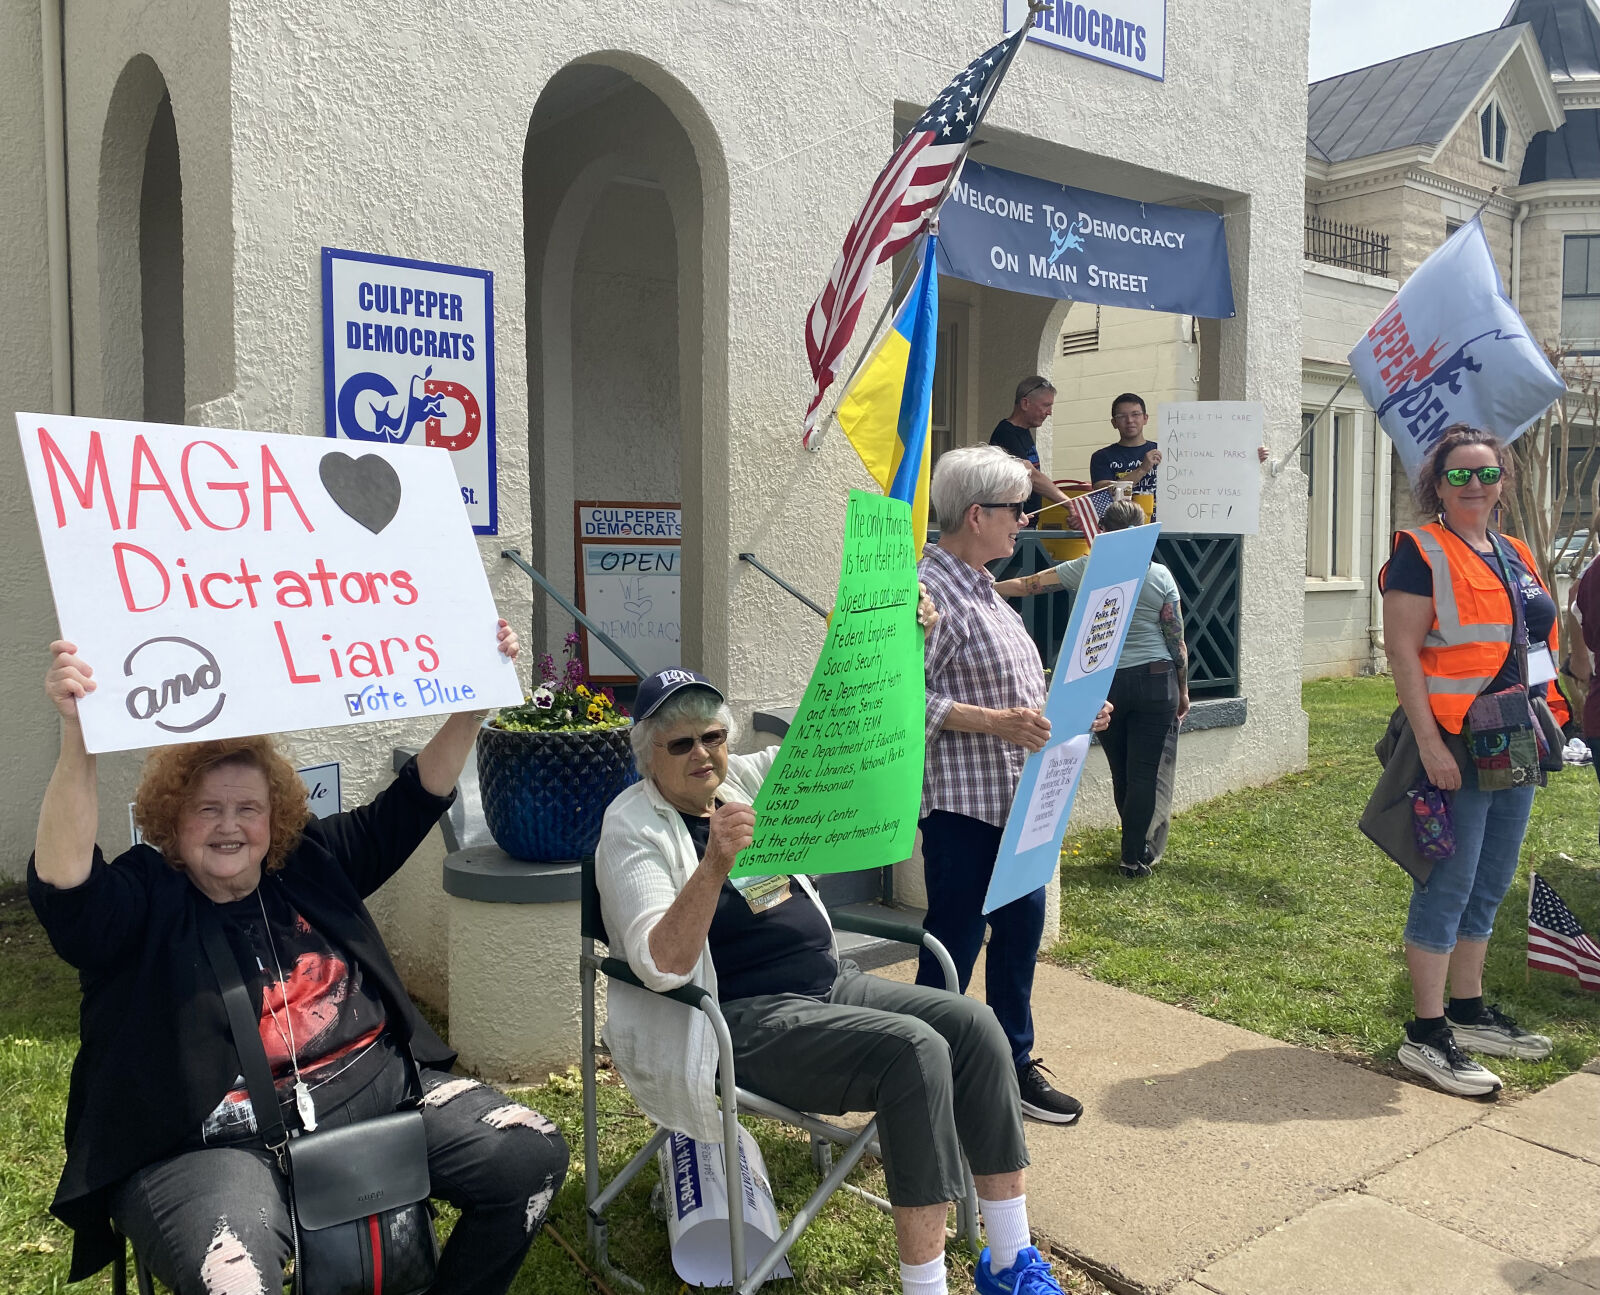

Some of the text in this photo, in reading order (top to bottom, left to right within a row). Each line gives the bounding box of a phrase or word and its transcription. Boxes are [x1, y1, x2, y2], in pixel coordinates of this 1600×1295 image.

[952, 180, 1033, 224] WELCOME
[1078, 212, 1185, 250] DEMOCRACY
[990, 245, 1148, 293] ON MAIN STREET
[358, 281, 463, 322] CULPEPER
[346, 320, 475, 362] DEMOCRATS
[1167, 410, 1252, 426] HEALTH CARE
[1168, 428, 1199, 443] ARTS
[1167, 447, 1247, 463] NATIONAL PARKS
[37, 427, 315, 533] MAGA
[1166, 465, 1194, 481] DATA
[1166, 484, 1211, 500] STUDENT
[1217, 487, 1241, 496] VISAS
[585, 522, 681, 537] DEMOCRATS
[591, 509, 676, 524] CULPEPER
[850, 499, 865, 538] The
[866, 503, 884, 546] only
[600, 551, 674, 572] OPEN
[856, 541, 873, 573] fear
[112, 542, 419, 613] Dictators
[619, 575, 651, 601] WE
[841, 584, 867, 625] Speak
[869, 591, 879, 616] up
[1104, 597, 1119, 608] Sorry
[832, 617, 897, 654] Federal Employees
[1085, 642, 1108, 656] Germans
[274, 620, 440, 684] Liars
[823, 652, 884, 680] Social Security
[126, 663, 222, 721] and
[414, 677, 477, 706] Blue
[814, 683, 833, 702] The
[835, 678, 881, 706] Department
[806, 697, 884, 722] and Human Services
[862, 714, 882, 732] FEMA
[788, 726, 907, 766] The Department of Education
[778, 763, 812, 780] Public
[859, 750, 888, 773] National
[888, 745, 905, 765] Parks
[771, 779, 855, 796] The Smithsonian
[758, 808, 860, 830] The Kennedy Center
[766, 799, 799, 812] USAID
[768, 832, 787, 848] the
[789, 832, 821, 848] other
[824, 823, 881, 848] departments
[881, 818, 900, 843] being
[738, 847, 811, 868] dismantled!
